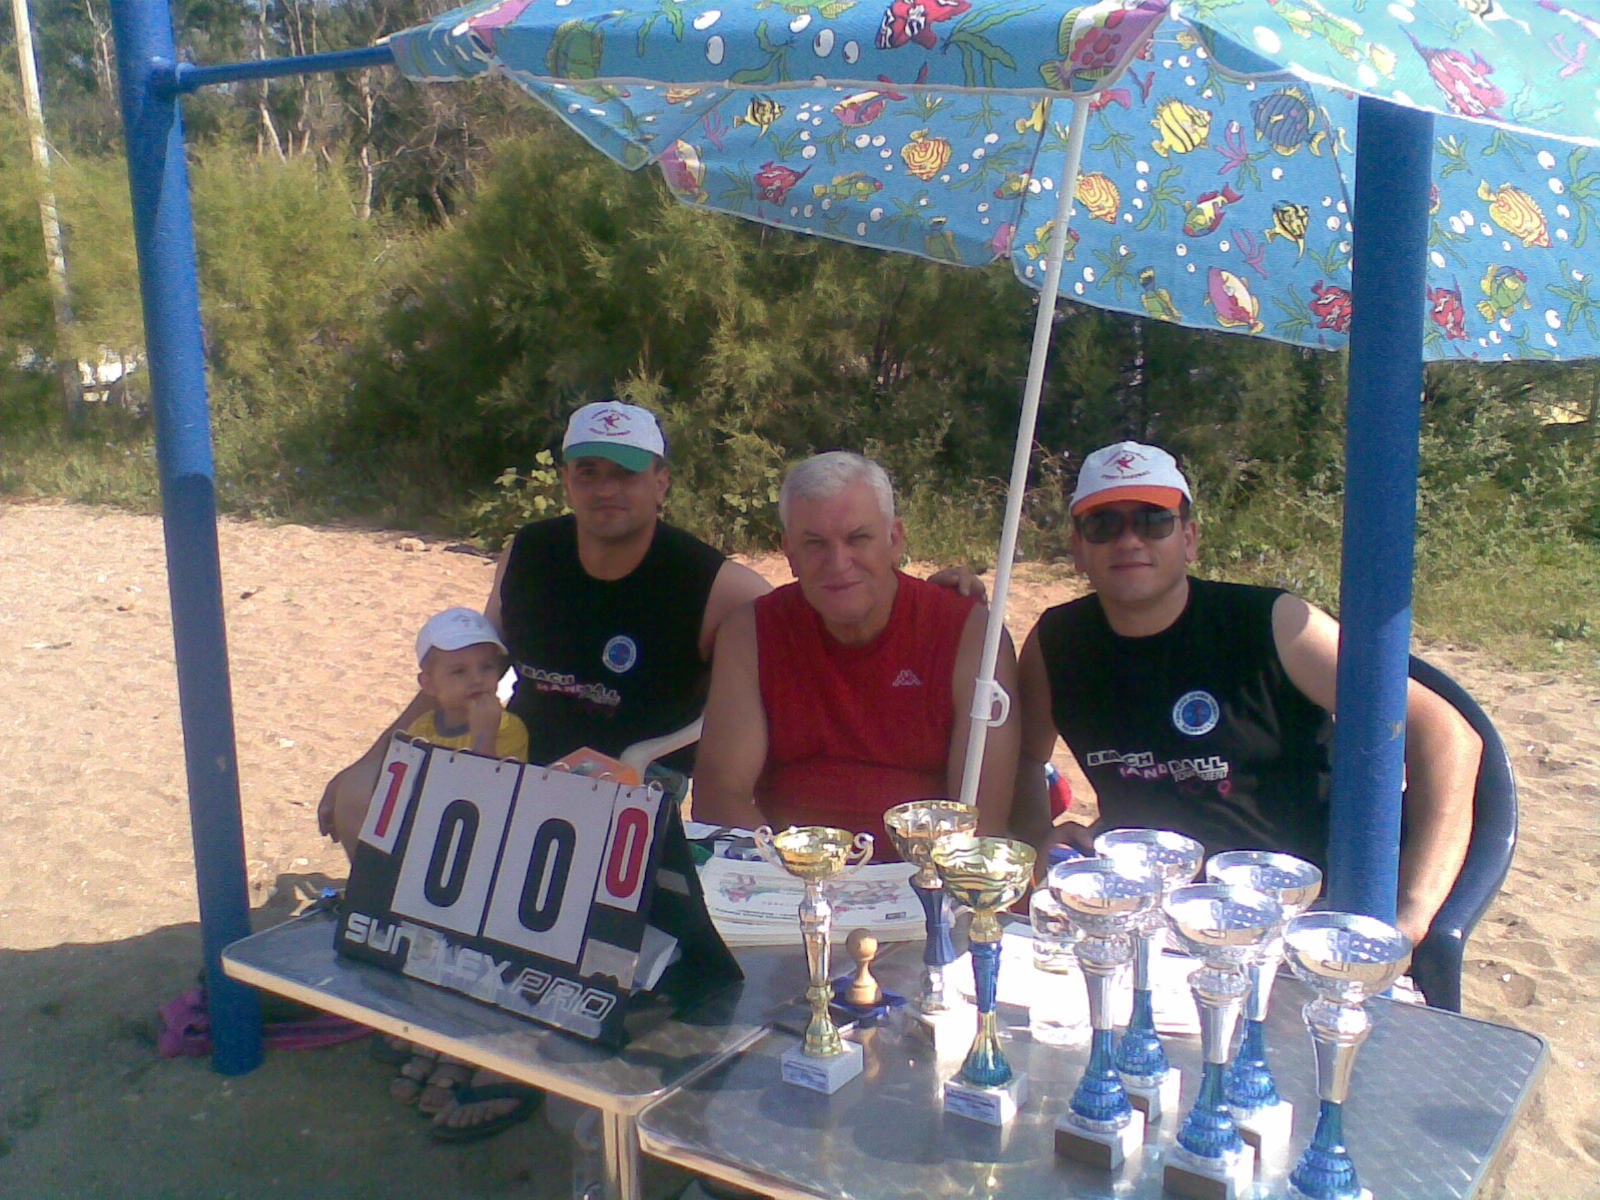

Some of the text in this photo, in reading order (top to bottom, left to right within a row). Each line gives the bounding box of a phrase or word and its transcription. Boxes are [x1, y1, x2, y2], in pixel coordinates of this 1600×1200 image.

[374, 761, 649, 932] 1 0 0 0
[512, 969, 617, 1022] PRO
